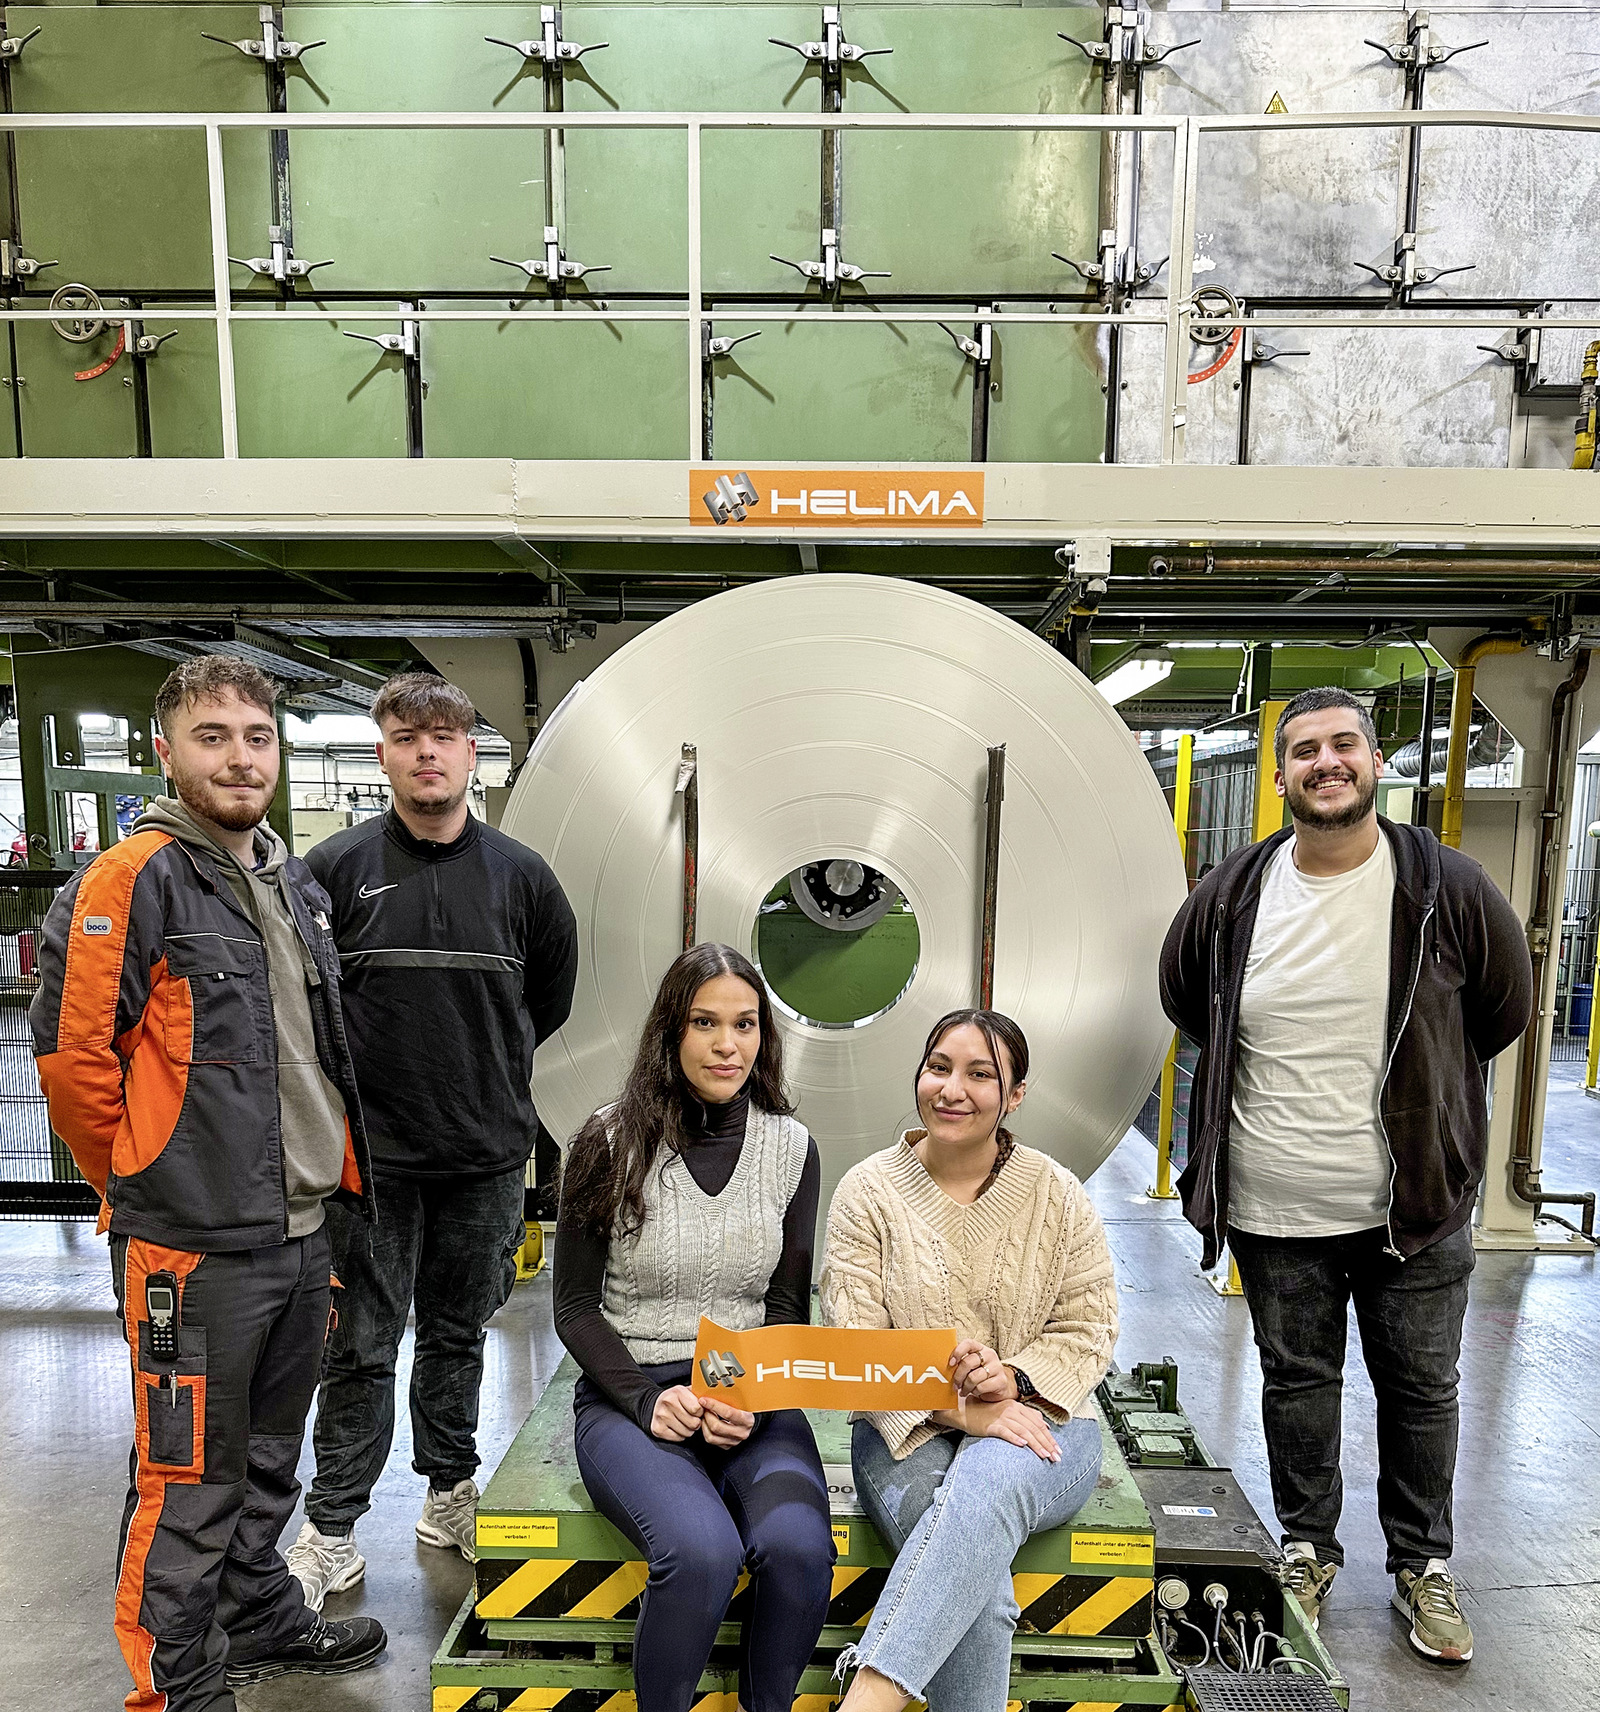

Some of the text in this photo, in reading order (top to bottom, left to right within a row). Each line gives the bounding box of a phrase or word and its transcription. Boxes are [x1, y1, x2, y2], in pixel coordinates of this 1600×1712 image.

[771, 489, 978, 516] HELIMA
[86, 920, 108, 931] boco
[756, 1359, 949, 1384] HELIMA
